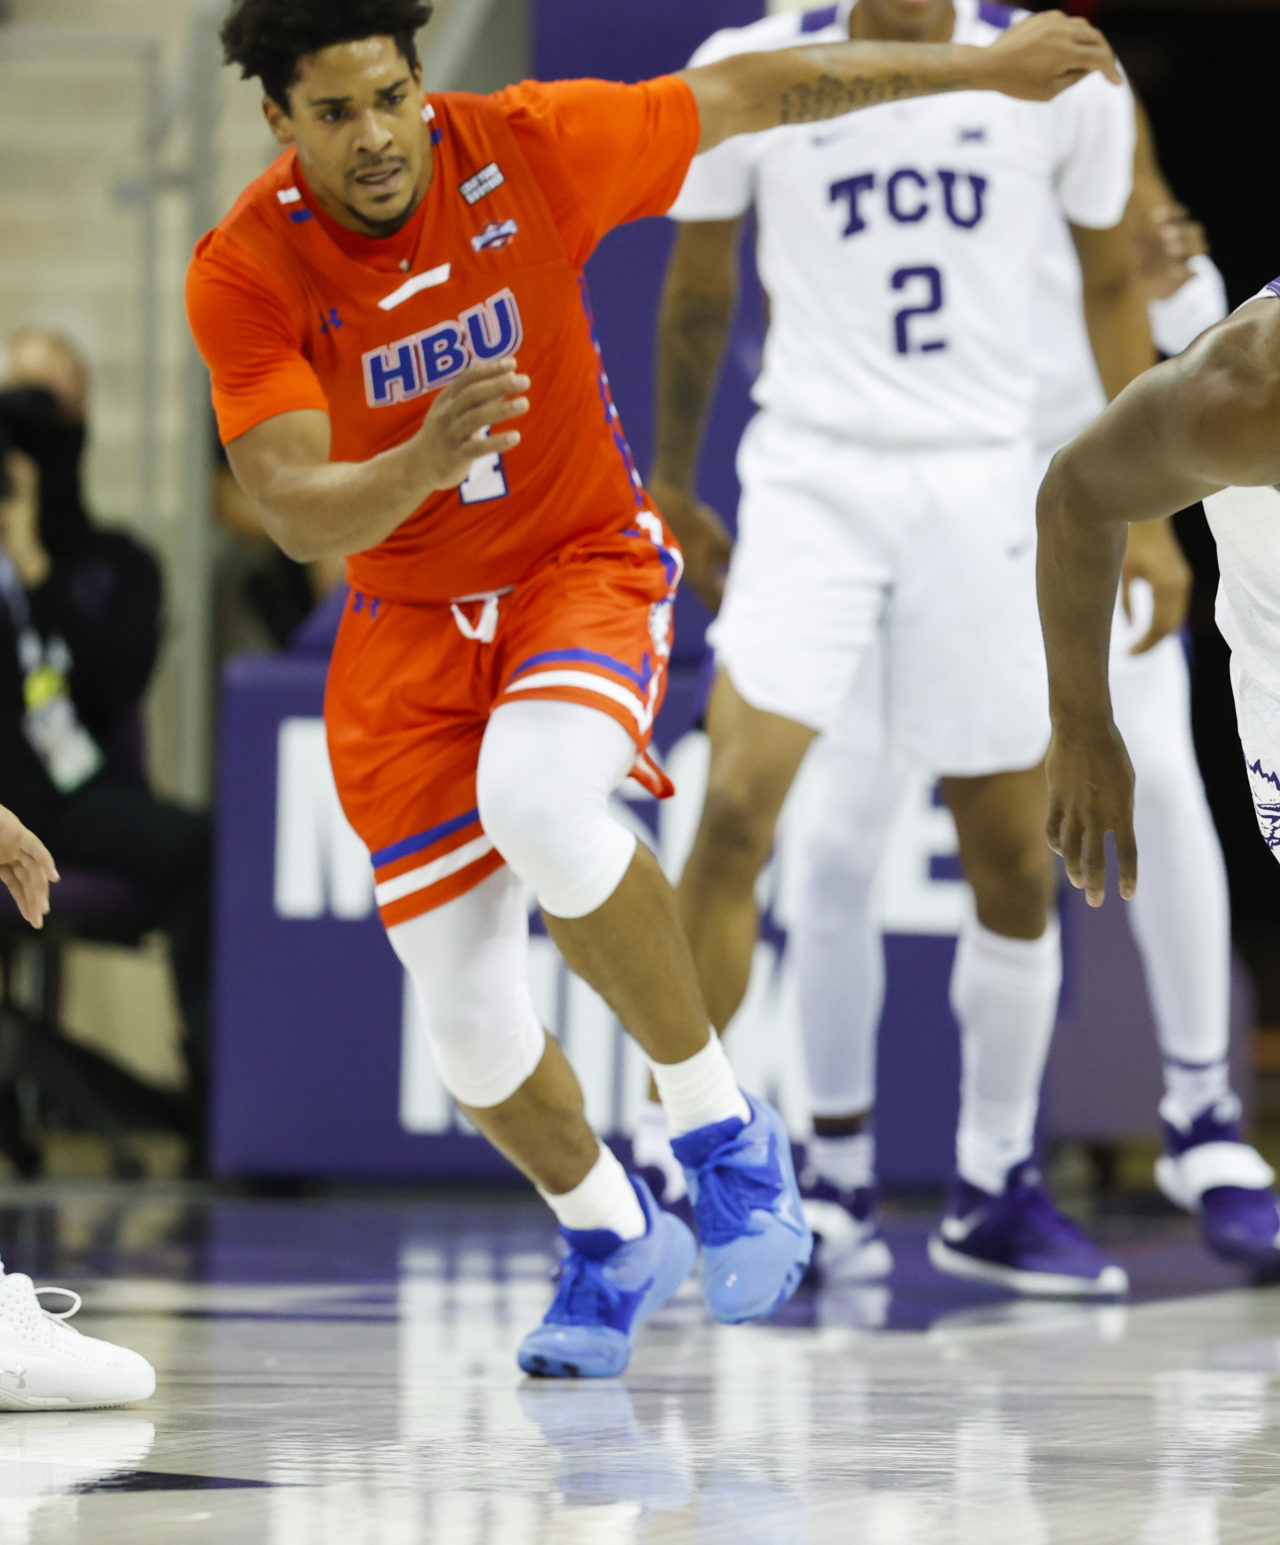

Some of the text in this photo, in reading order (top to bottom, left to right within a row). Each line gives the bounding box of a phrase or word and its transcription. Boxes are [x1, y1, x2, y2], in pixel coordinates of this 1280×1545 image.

[829, 168, 987, 239] TCU
[363, 289, 522, 406] HBU
[890, 265, 948, 355] 2
